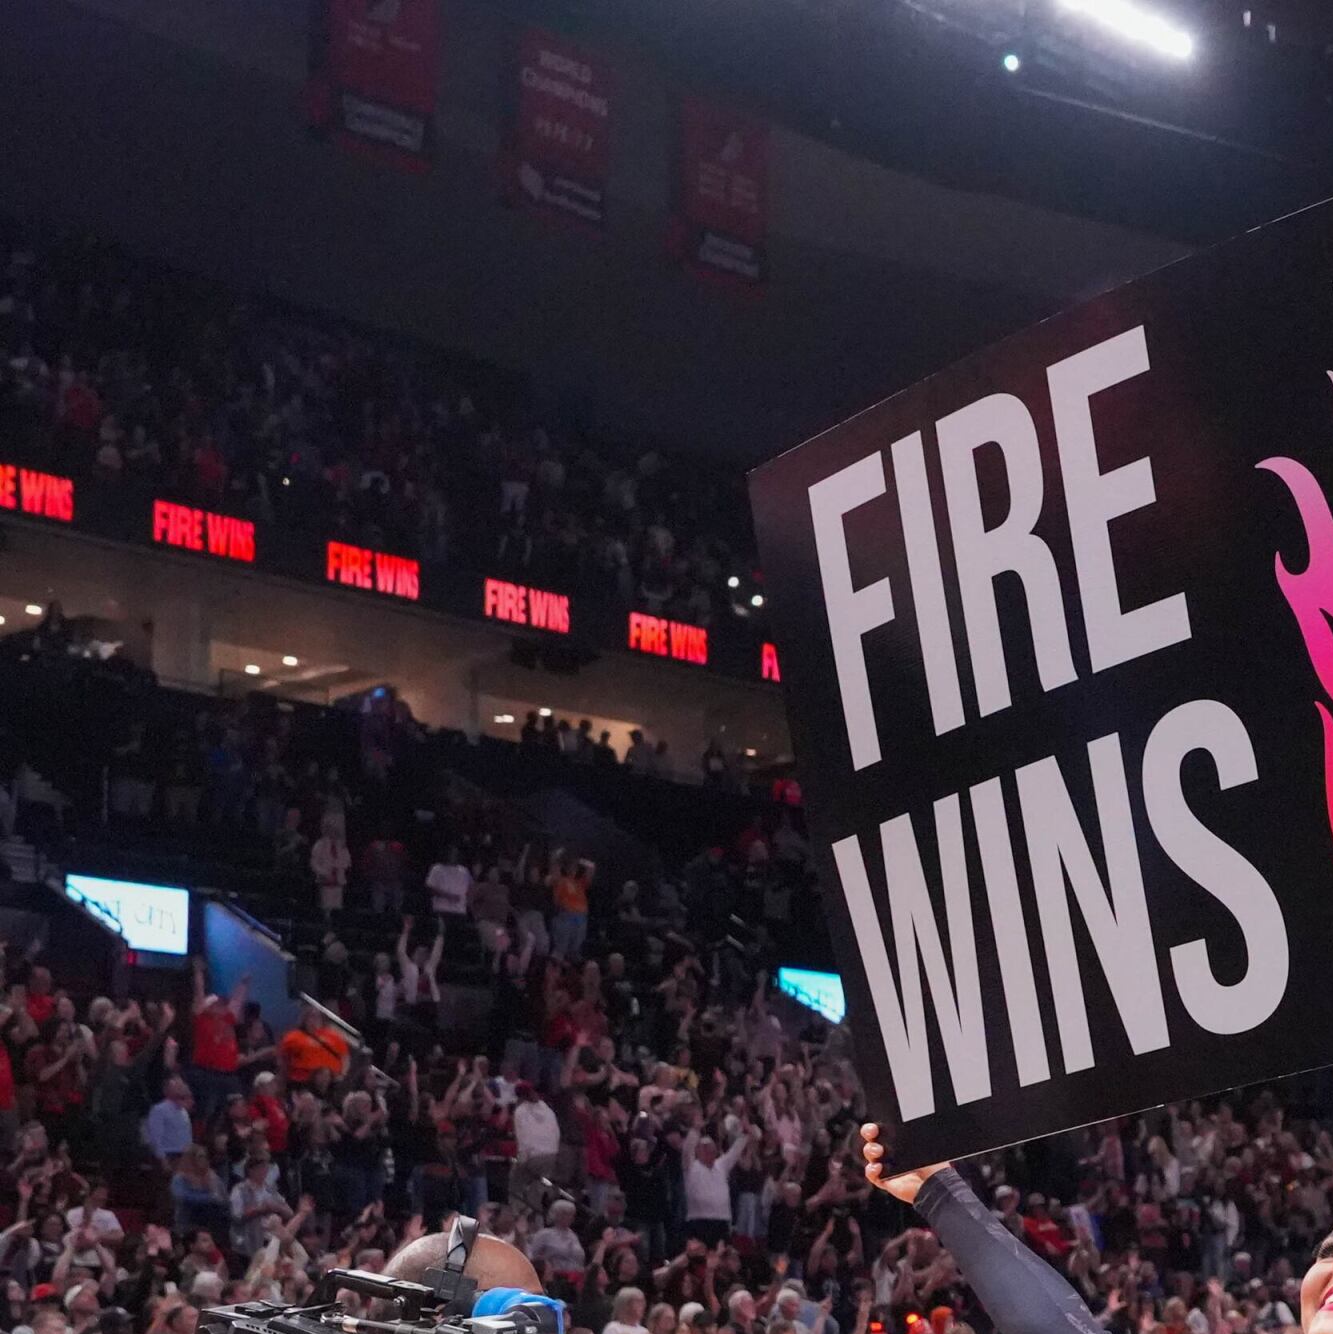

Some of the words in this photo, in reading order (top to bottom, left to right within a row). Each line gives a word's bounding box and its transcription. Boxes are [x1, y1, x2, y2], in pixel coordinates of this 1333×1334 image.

[20, 469, 74, 522] WINS
[153, 500, 203, 551] FIRE
[207, 512, 255, 562] WINS
[808, 325, 1192, 771] FIRE
[327, 541, 372, 589] FIRE
[375, 552, 420, 600] WINS
[485, 577, 526, 624] FIRE
[529, 588, 569, 633] WINS
[629, 611, 668, 656] FIRE
[670, 621, 707, 665] WINS
[831, 699, 1289, 1122] WINS
